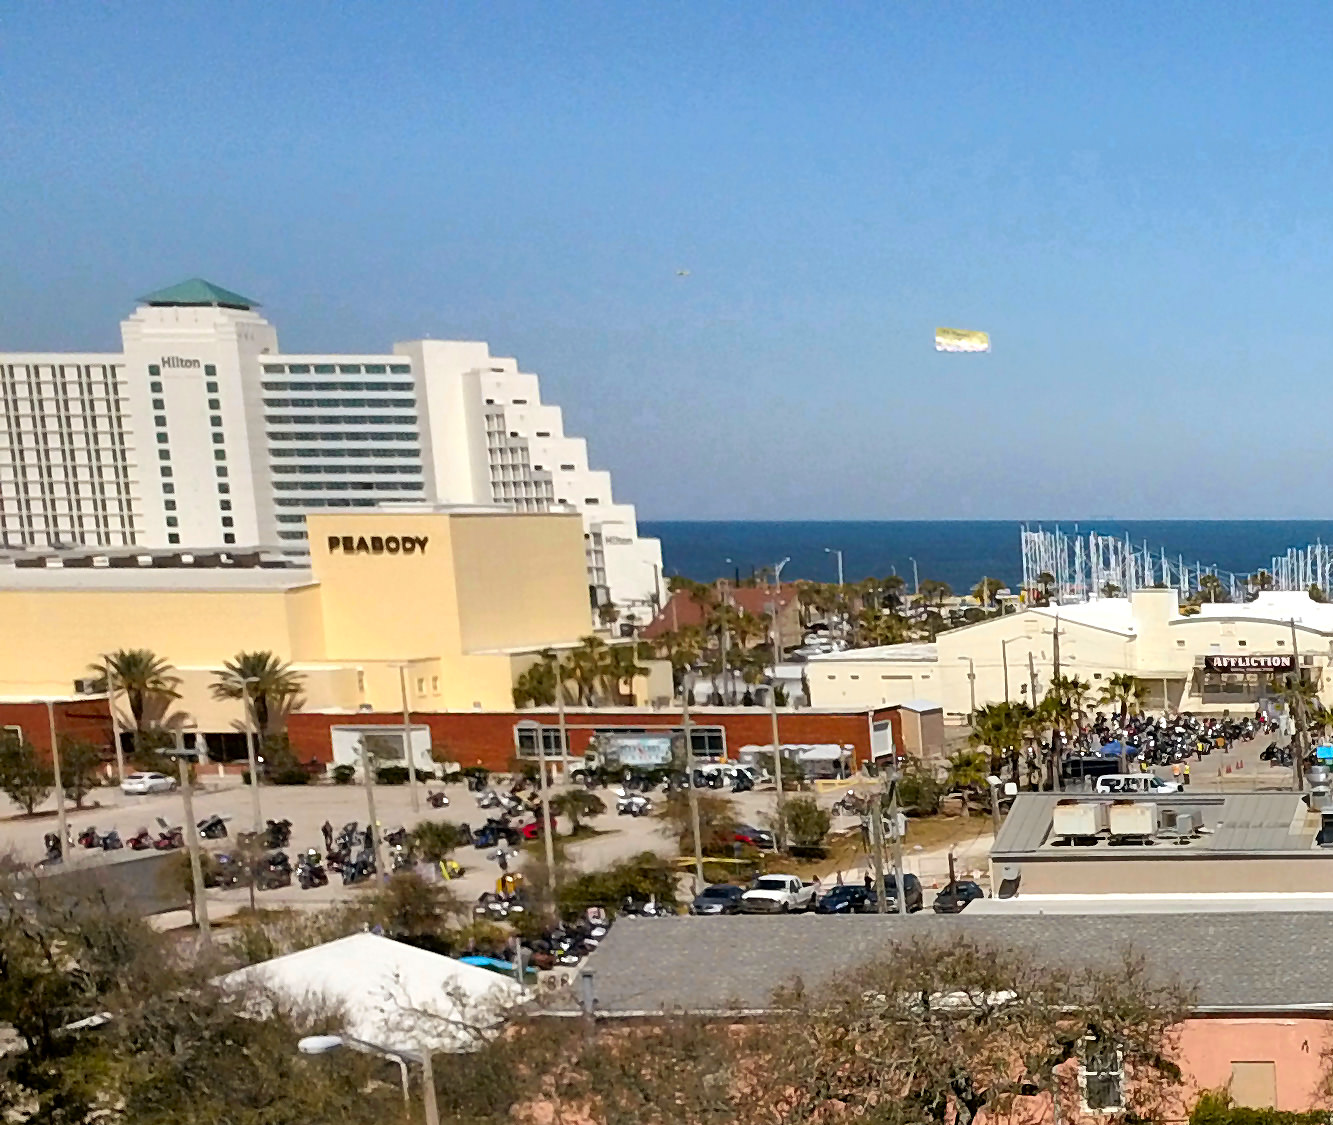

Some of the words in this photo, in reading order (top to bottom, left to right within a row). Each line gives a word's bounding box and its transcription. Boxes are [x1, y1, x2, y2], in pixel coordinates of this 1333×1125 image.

[161, 356, 200, 368] Hilton
[327, 536, 429, 555] PEABODY
[1213, 656, 1291, 667] AFFLICTION
